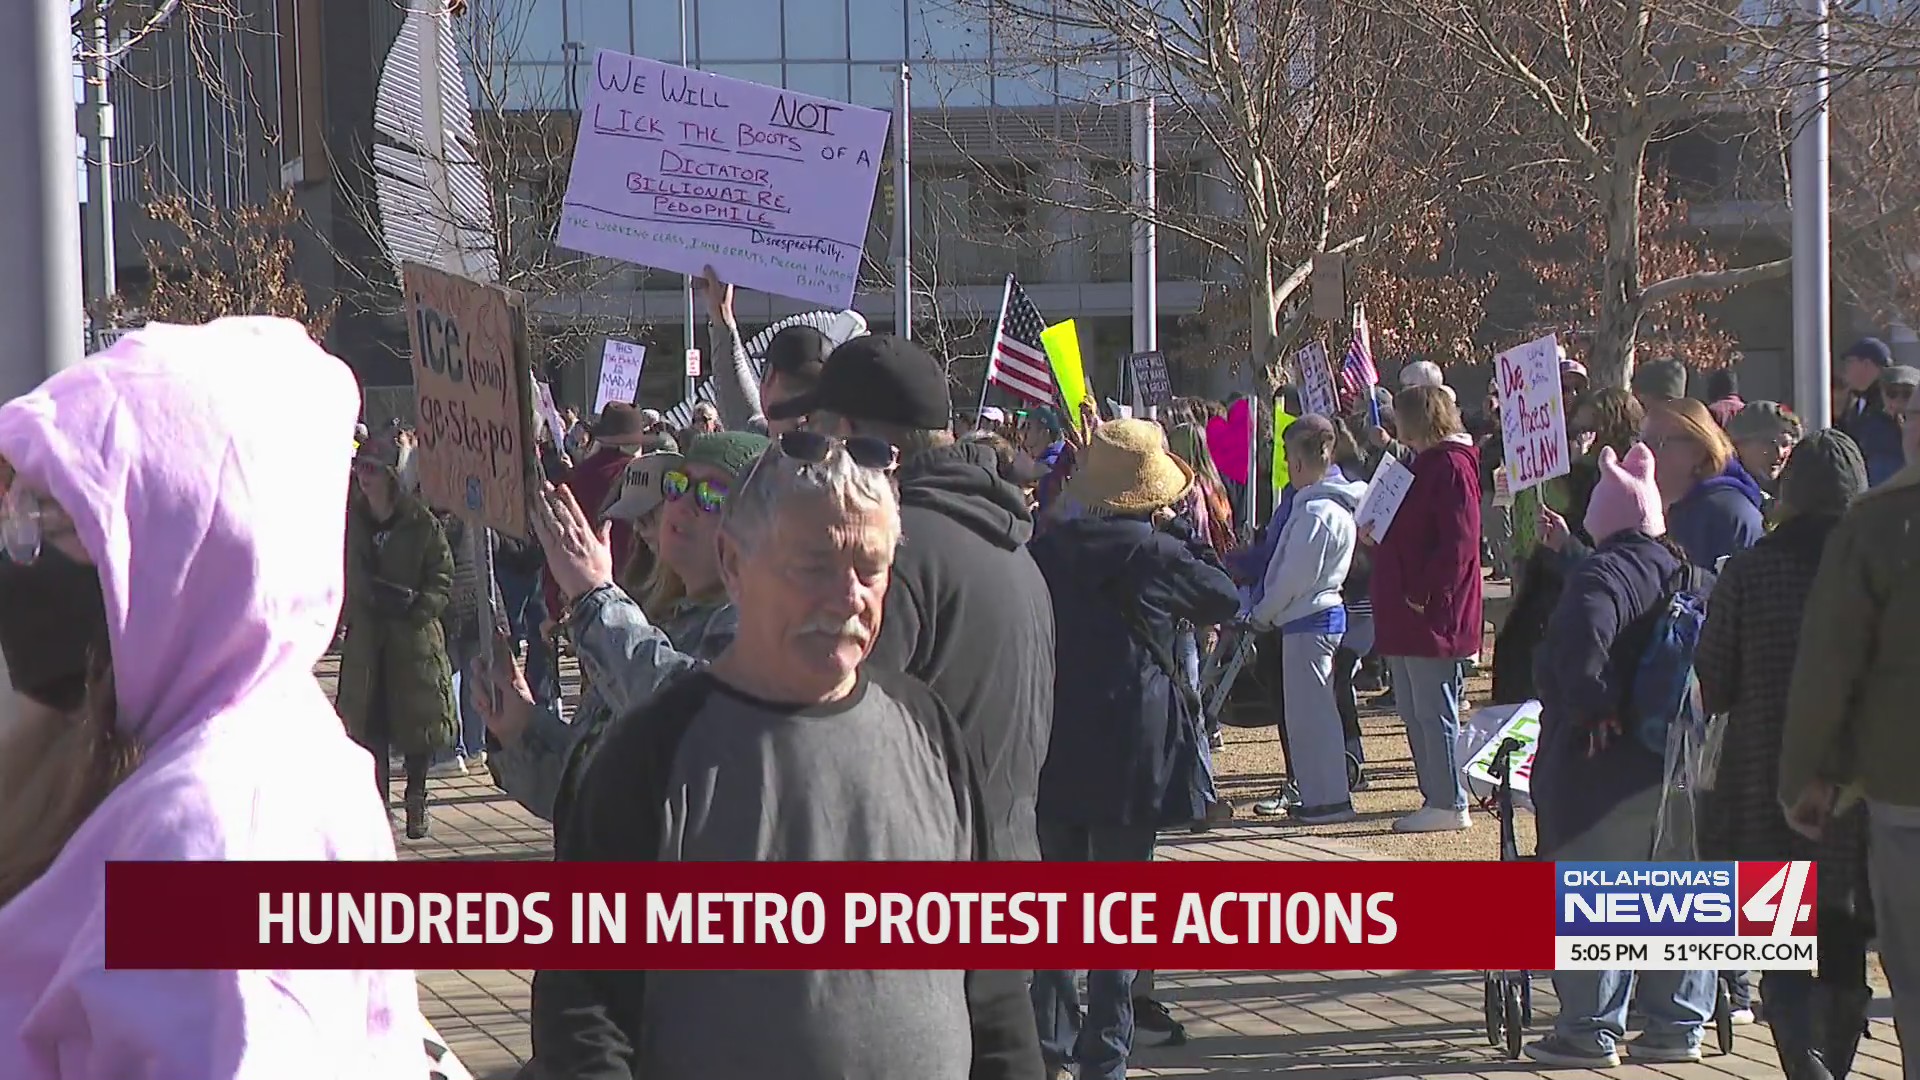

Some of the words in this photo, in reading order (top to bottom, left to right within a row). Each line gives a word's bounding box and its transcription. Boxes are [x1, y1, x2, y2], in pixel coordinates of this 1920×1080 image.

[597, 52, 647, 94] WE
[661, 69, 729, 108] WILL
[768, 94, 843, 133] NOT
[594, 104, 664, 134] LICK
[679, 119, 725, 144] THE
[738, 123, 802, 152] BOOTS
[821, 146, 847, 161] OF
[856, 149, 871, 168] A
[660, 150, 773, 189] DICTATOR,
[654, 196, 767, 223] PEDOPHILE
